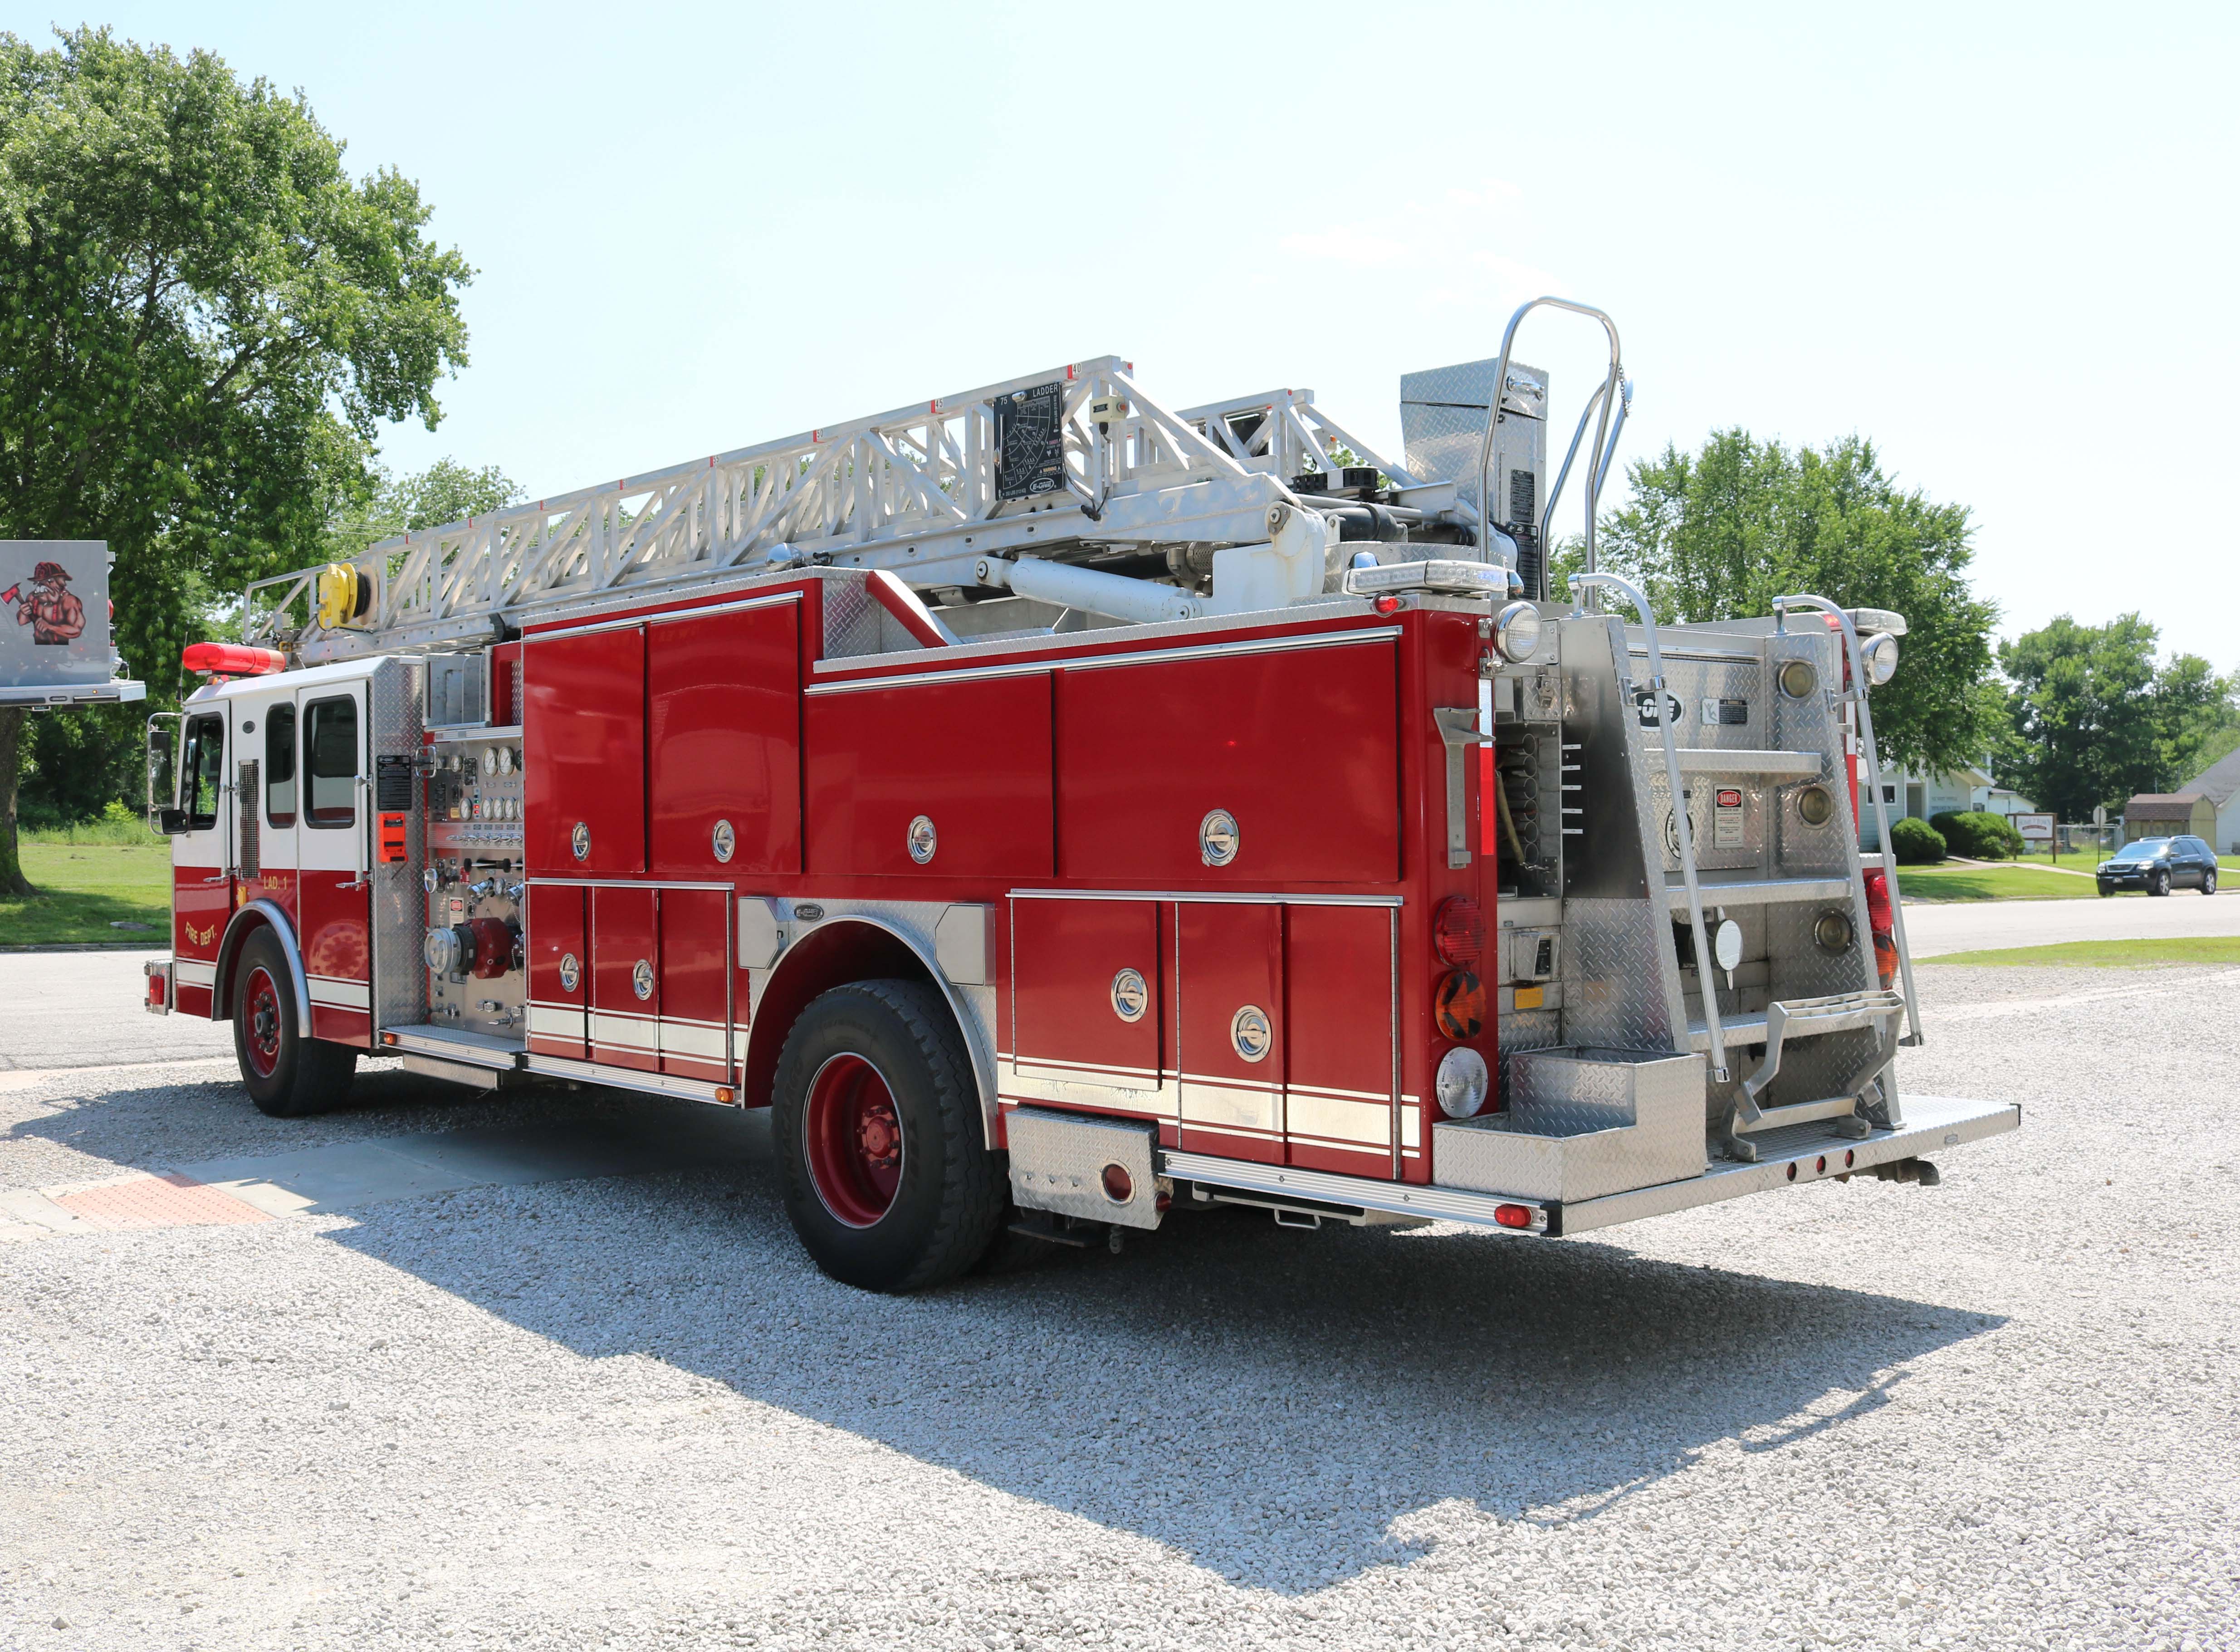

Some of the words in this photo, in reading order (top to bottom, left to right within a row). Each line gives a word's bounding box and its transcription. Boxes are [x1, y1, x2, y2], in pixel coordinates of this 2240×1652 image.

[1073, 363, 1081, 373] 40
[1000, 396, 1008, 406] 75
[1032, 384, 1058, 397] LADDER
[935, 399, 943, 408] 45
[817, 429, 823, 438] 50
[713, 455, 719, 463] 55
[1032, 481, 1052, 490] E-ONE
[1720, 794, 1738, 803] DANGER
[264, 876, 280, 890] LAD.
[283, 876, 287, 890] 1
[796, 909, 817, 917] E-ONE
[185, 921, 198, 944] FIRE
[200, 924, 217, 946] DEPT.
